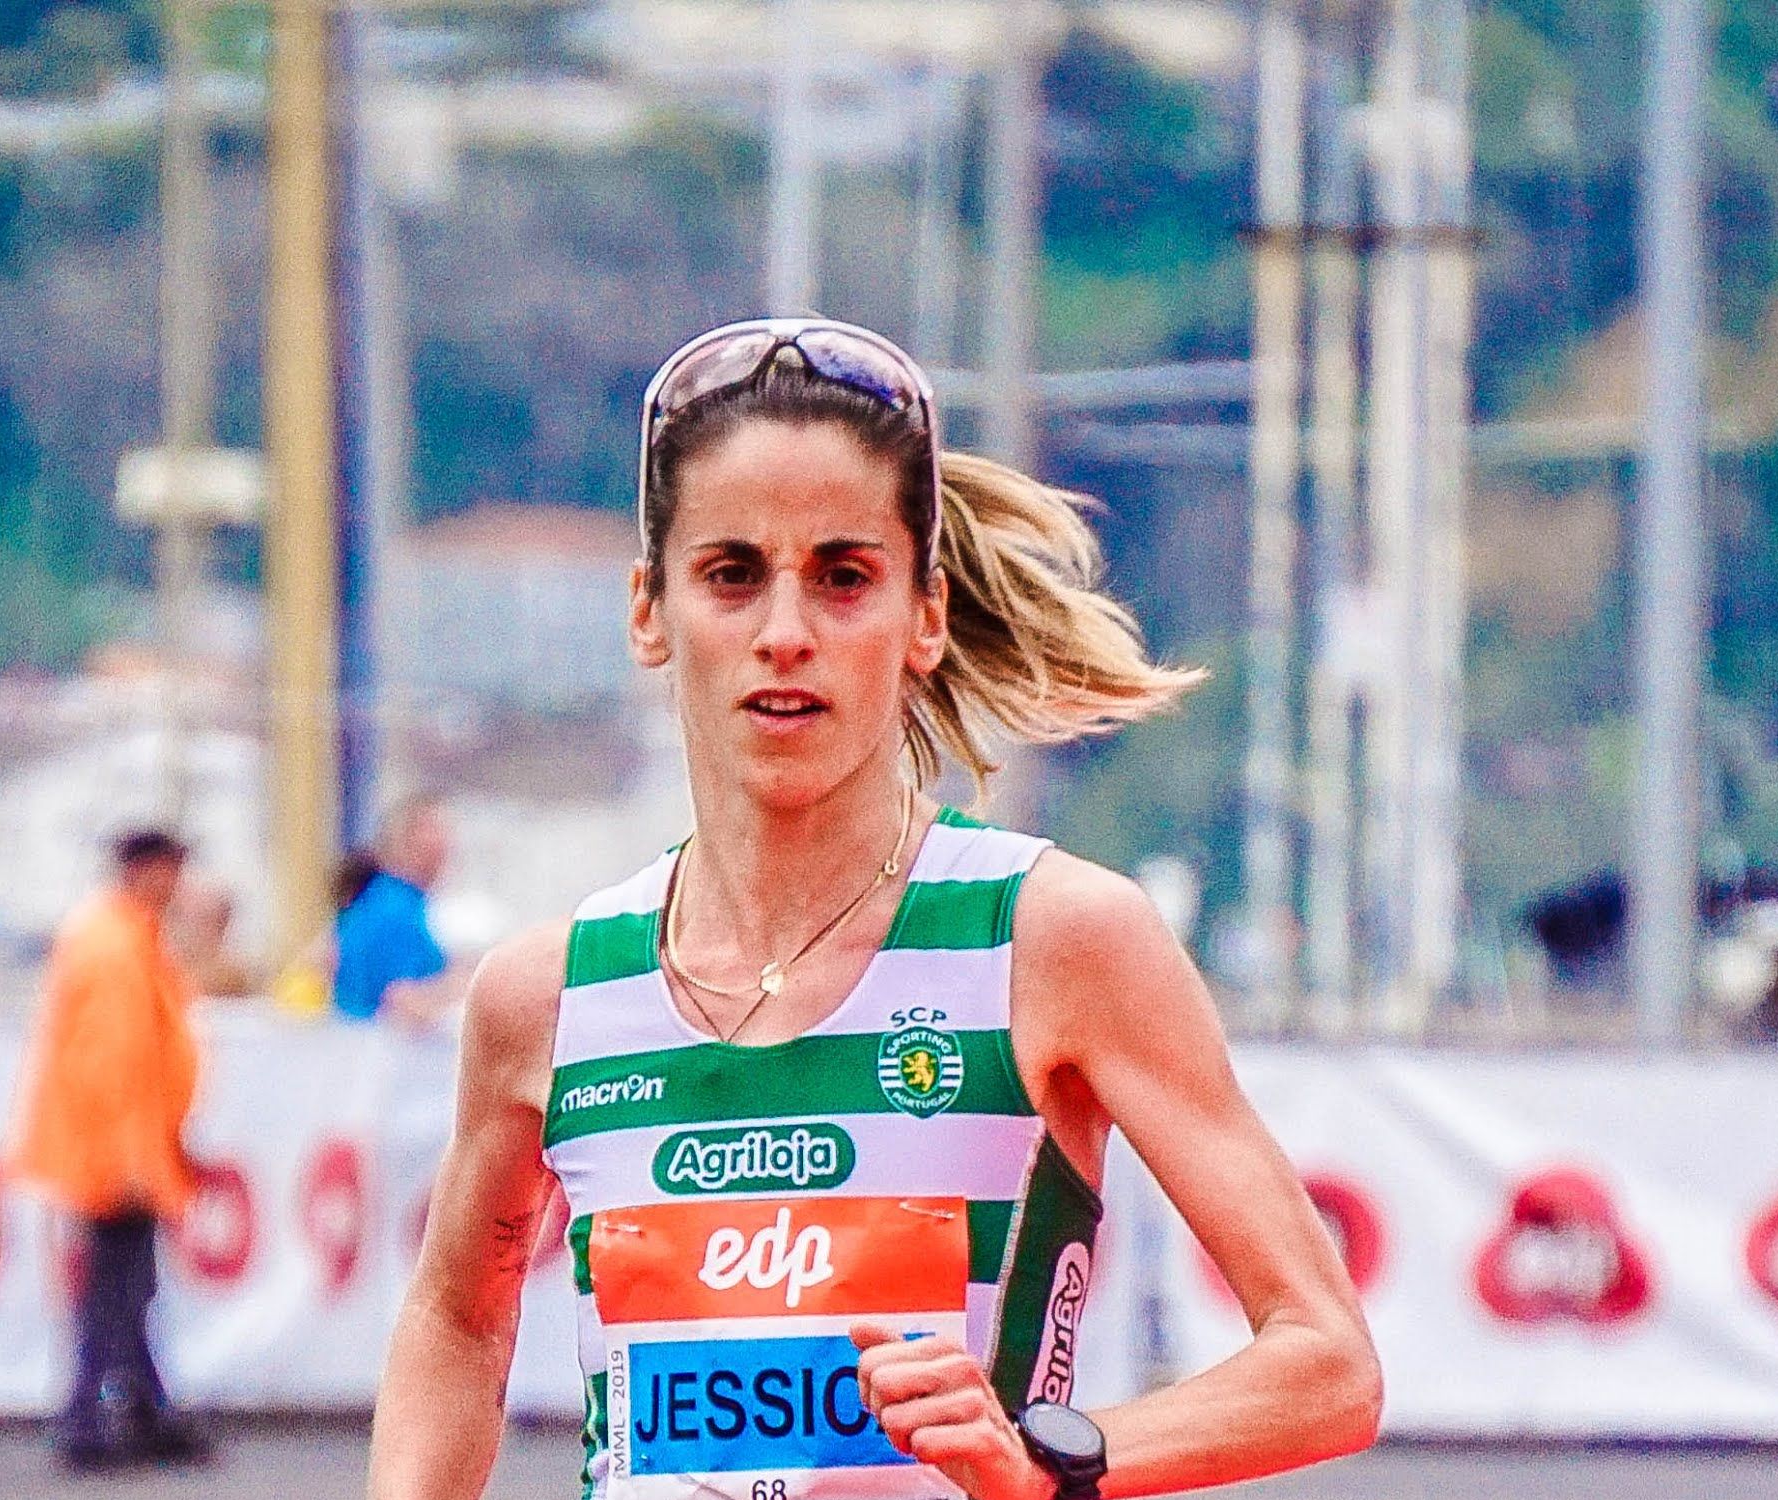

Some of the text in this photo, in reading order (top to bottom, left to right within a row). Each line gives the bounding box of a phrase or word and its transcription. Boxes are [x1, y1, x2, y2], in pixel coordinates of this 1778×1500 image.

[886, 1030, 953, 1056] SPORTING
[890, 1006, 947, 1028] SCP
[667, 1128, 838, 1189] Agriloja
[698, 1206, 834, 1308] edp
[1036, 1261, 1085, 1404] Agrilo
[611, 1350, 625, 1399] 2019
[635, 1366, 886, 1443] JESSIC
